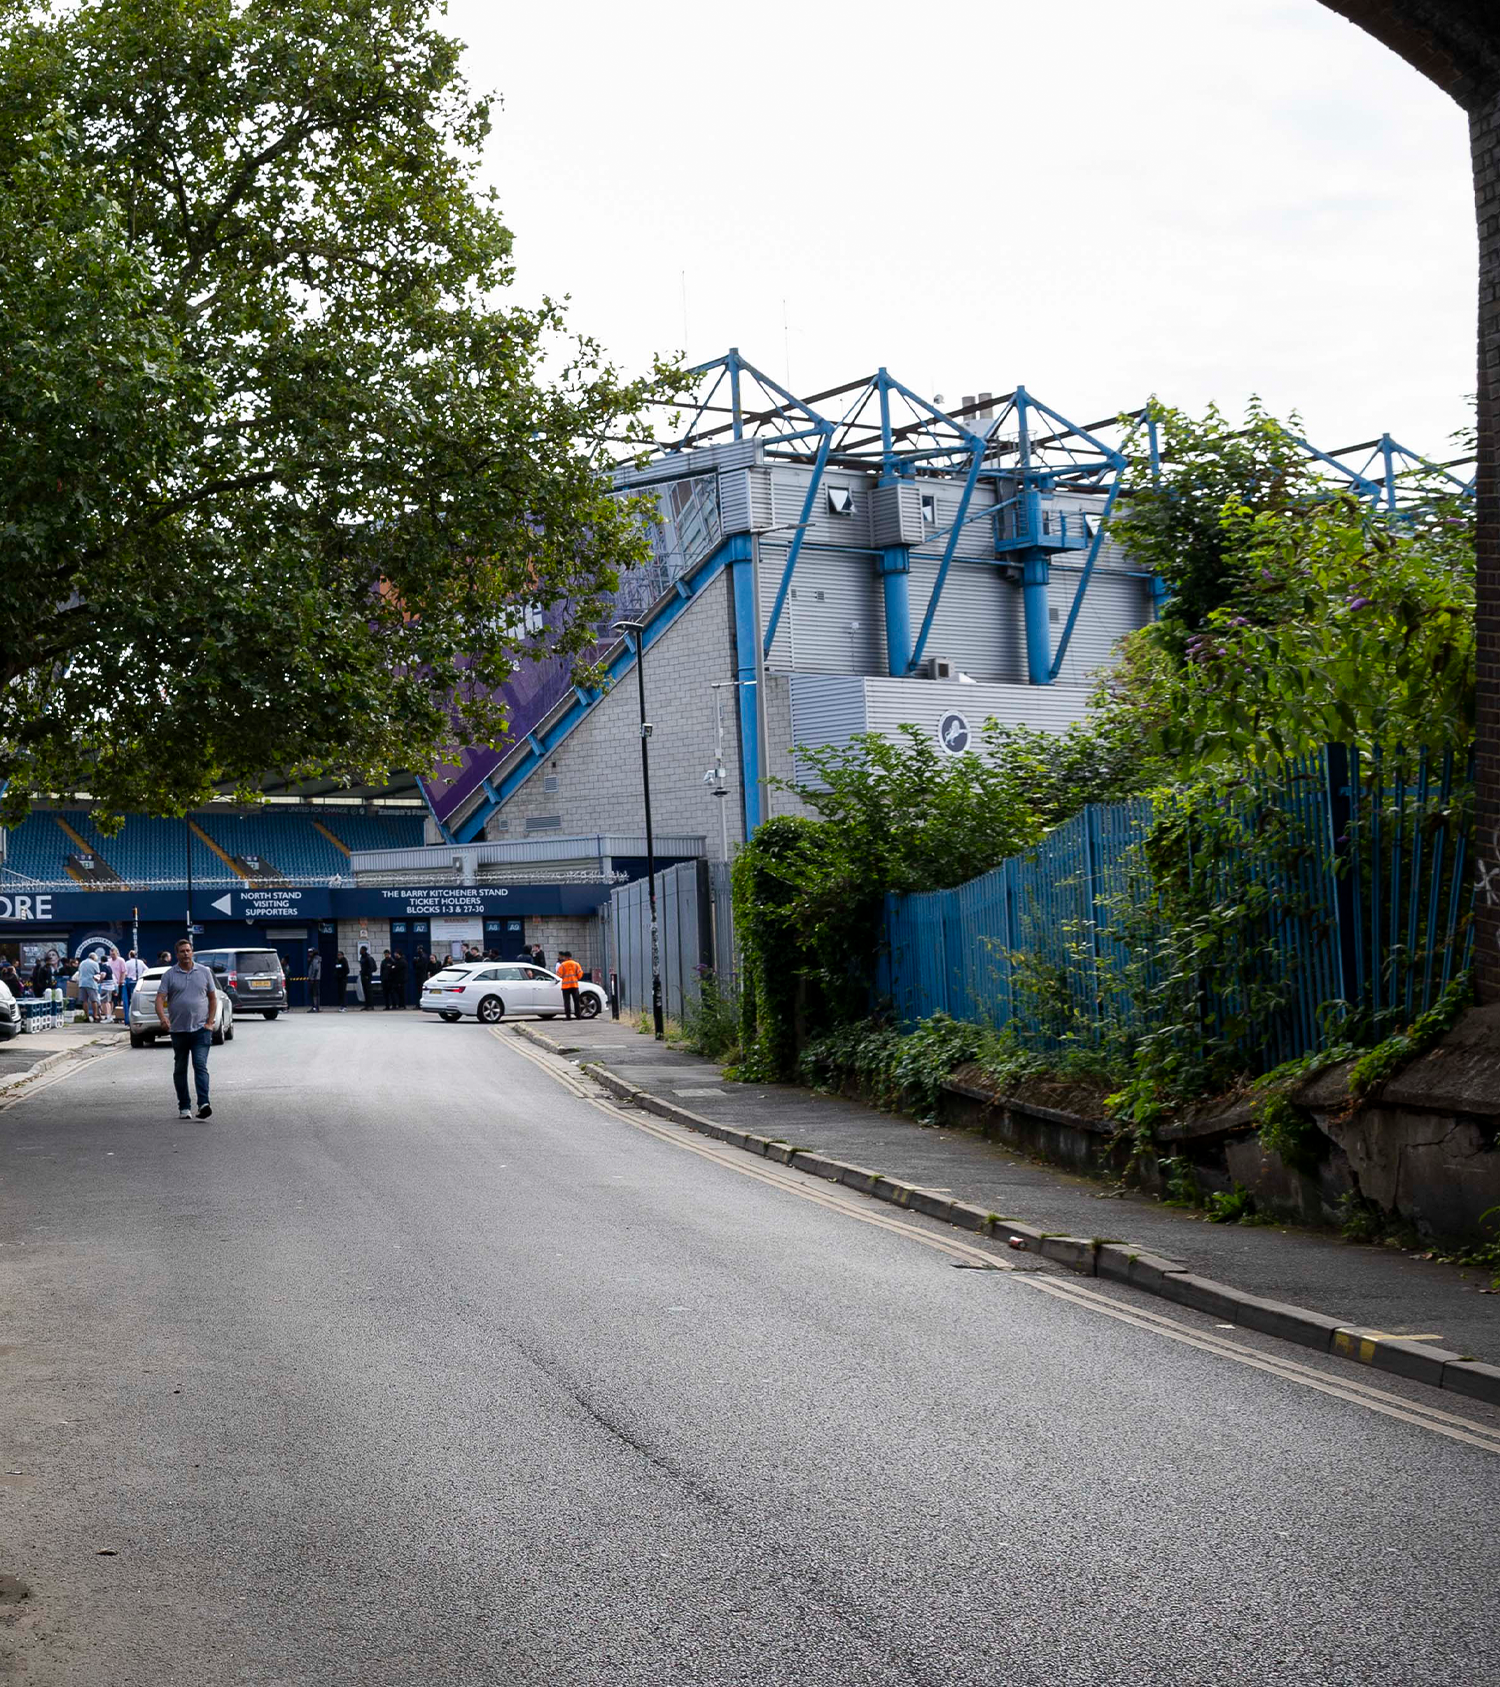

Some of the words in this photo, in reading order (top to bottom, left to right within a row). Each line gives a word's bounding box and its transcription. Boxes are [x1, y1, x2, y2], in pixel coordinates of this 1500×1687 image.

[241, 892, 272, 900] NORTH
[382, 890, 400, 898] THE
[400, 889, 428, 898] BARRY
[429, 889, 477, 897] KITCHENER
[479, 888, 509, 897] STAND
[253, 900, 289, 908] VISITING
[410, 898, 440, 906] TICKET
[441, 897, 482, 905] HOLDERS
[245, 908, 298, 916] SUPPORTERS
[406, 906, 440, 914] BLOCKS
[442, 905, 454, 913] 1-3
[455, 905, 461, 913] &
[463, 905, 485, 913] 27-30
